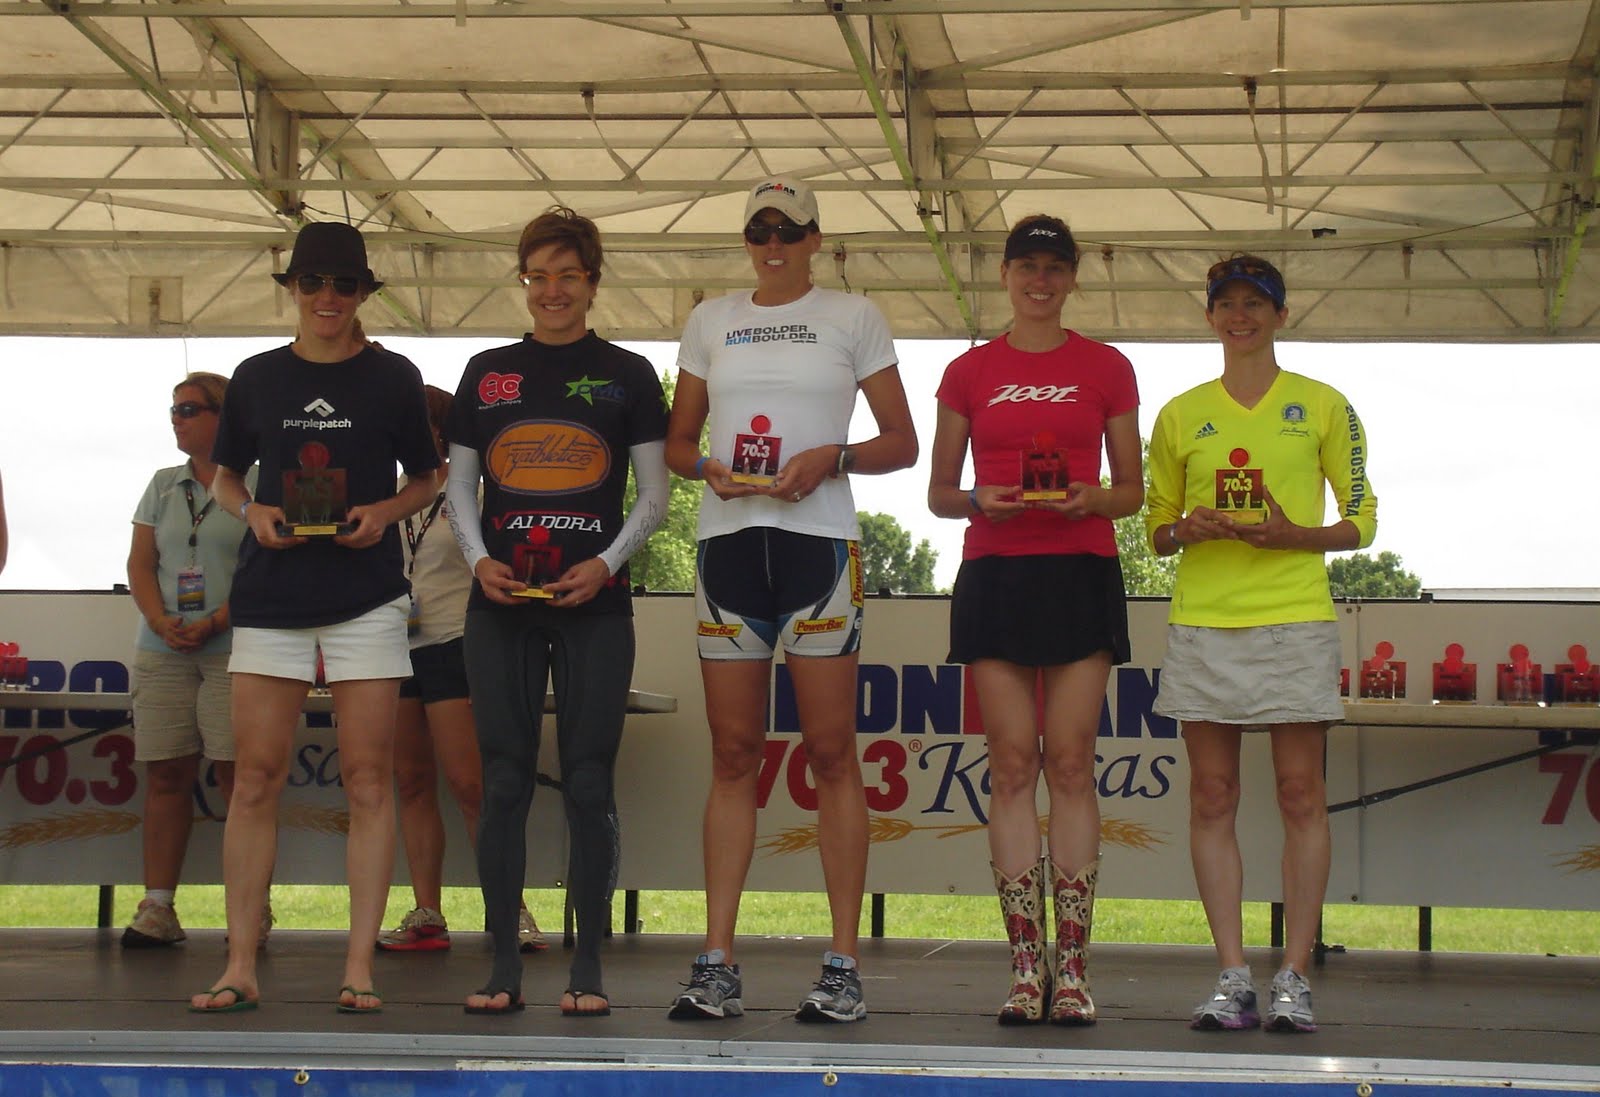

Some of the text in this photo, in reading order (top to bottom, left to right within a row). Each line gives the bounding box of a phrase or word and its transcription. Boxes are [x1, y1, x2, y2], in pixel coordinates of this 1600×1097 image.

[283, 418, 352, 431] purplepatch
[1345, 404, 1360, 442] 2009
[742, 443, 770, 458] 70.3
[1350, 446, 1365, 502] BOSTON
[1223, 478, 1253, 491] 70.3
[796, 617, 844, 632] PowerBar
